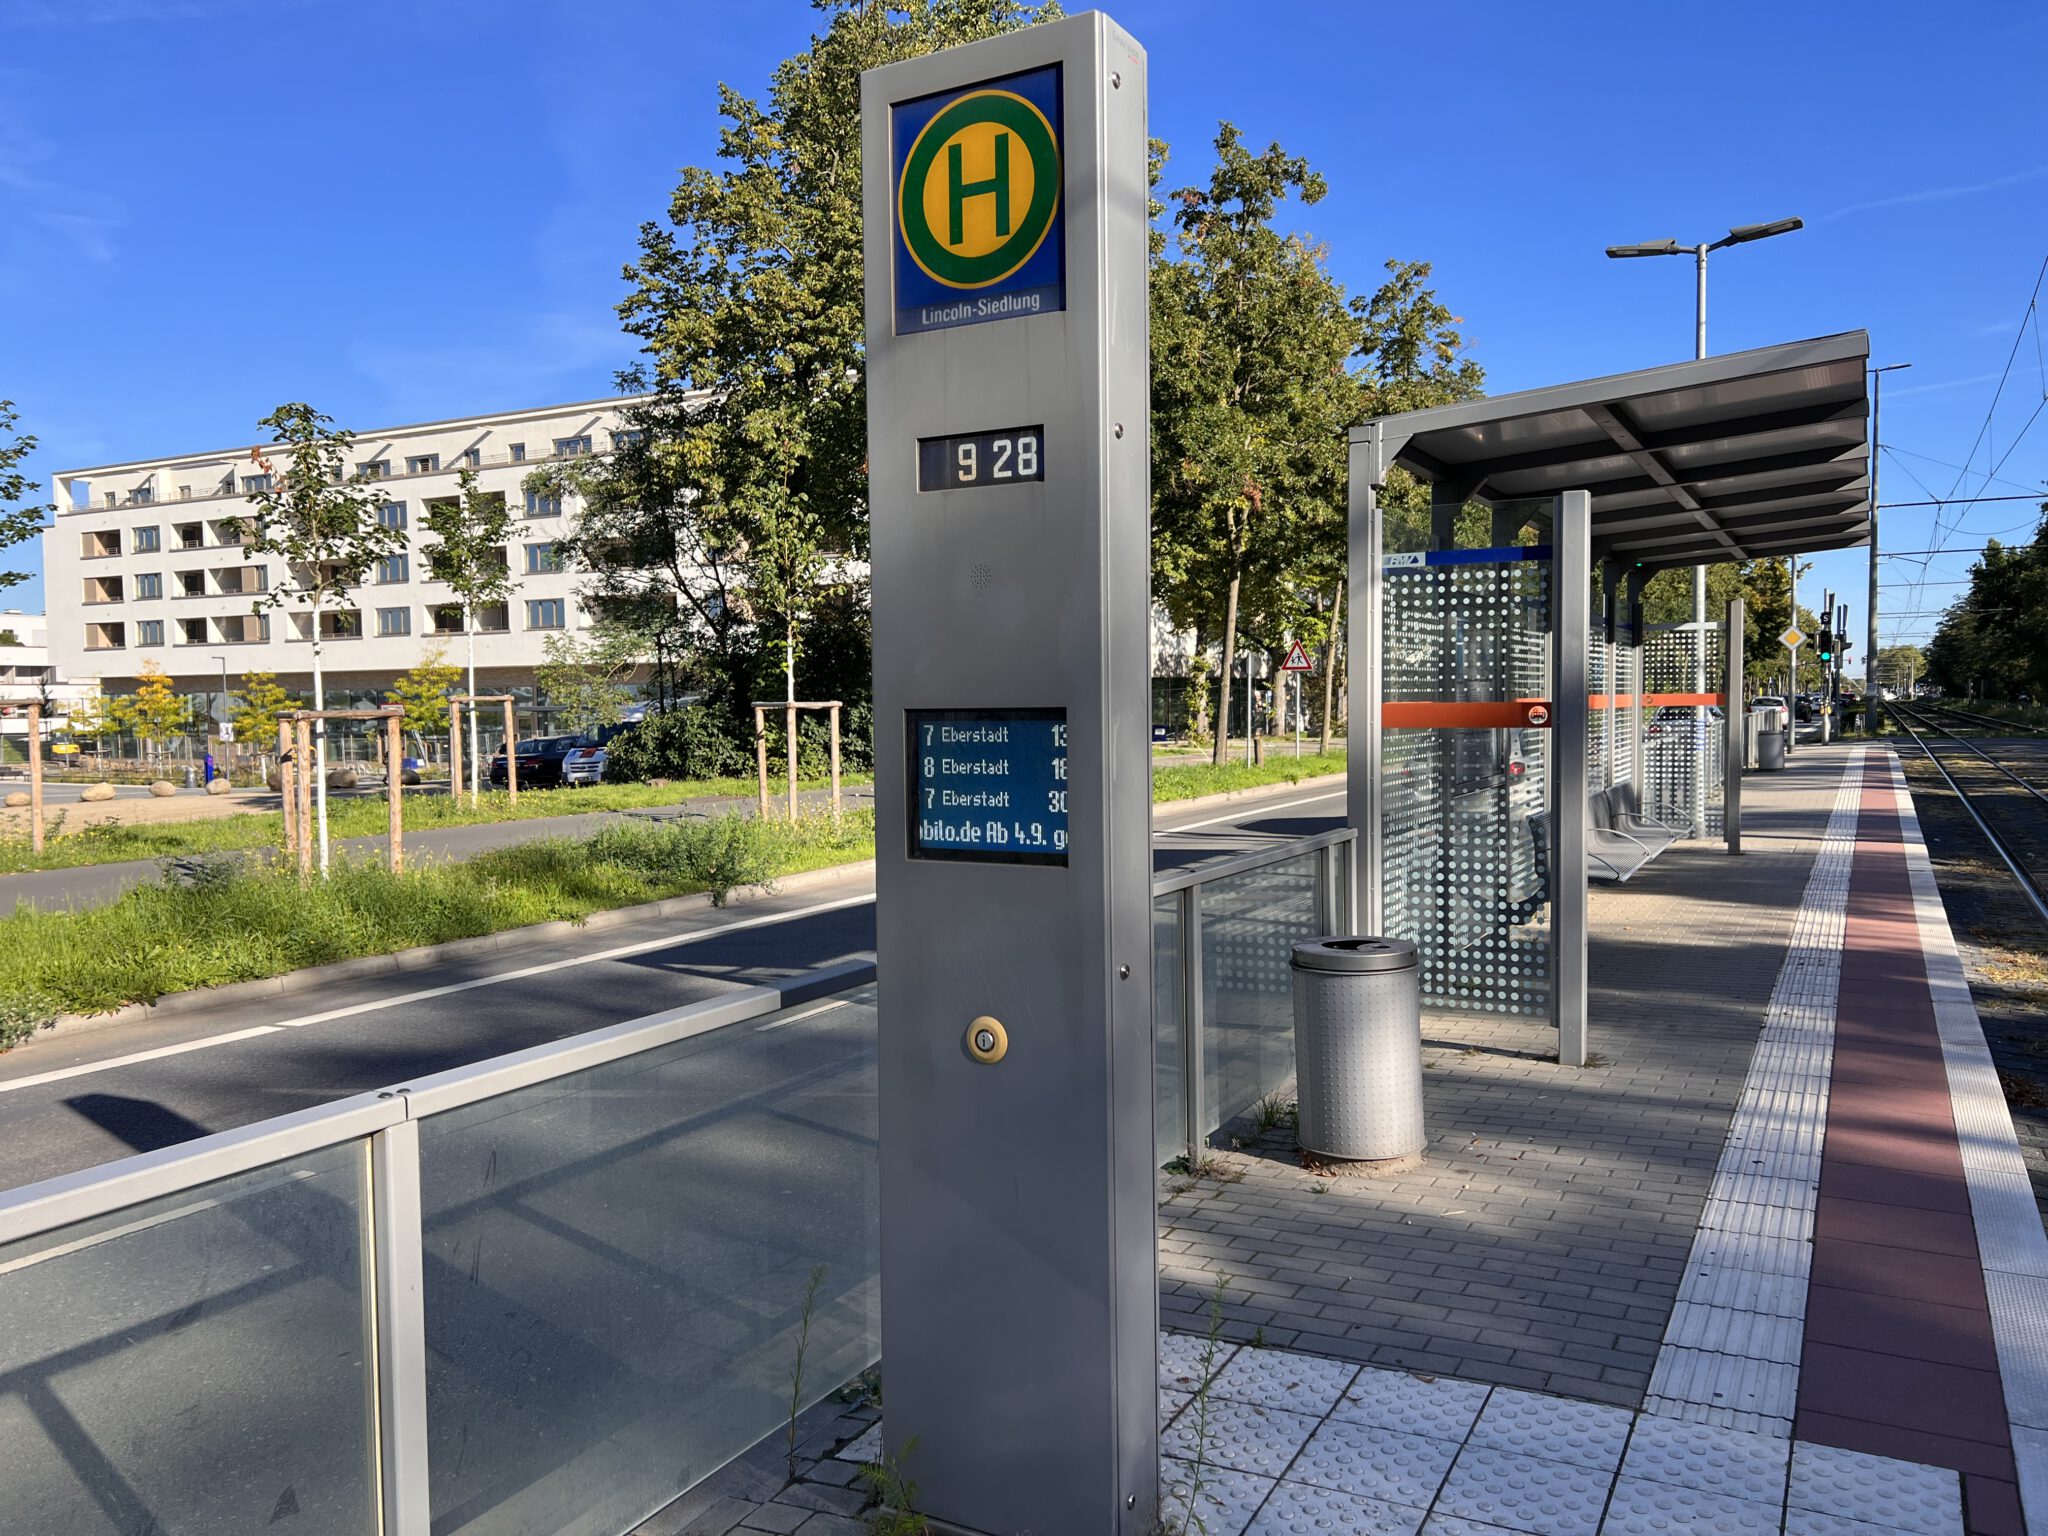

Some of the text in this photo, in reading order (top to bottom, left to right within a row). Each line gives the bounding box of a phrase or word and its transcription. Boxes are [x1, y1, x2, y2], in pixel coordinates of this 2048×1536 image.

[948, 132, 1010, 245] H
[921, 293, 1040, 325] Lincoln-Siedlung
[958, 436, 1038, 481] 9 28
[923, 725, 934, 746] 7
[941, 726, 1009, 743] Eberstadt
[924, 756, 935, 778] 8
[942, 758, 1009, 775] Eberstadt
[924, 787, 935, 809] 7
[942, 790, 1010, 808] Eberstadt
[986, 821, 1009, 844] Ab
[1014, 822, 1047, 845] 4.9.
